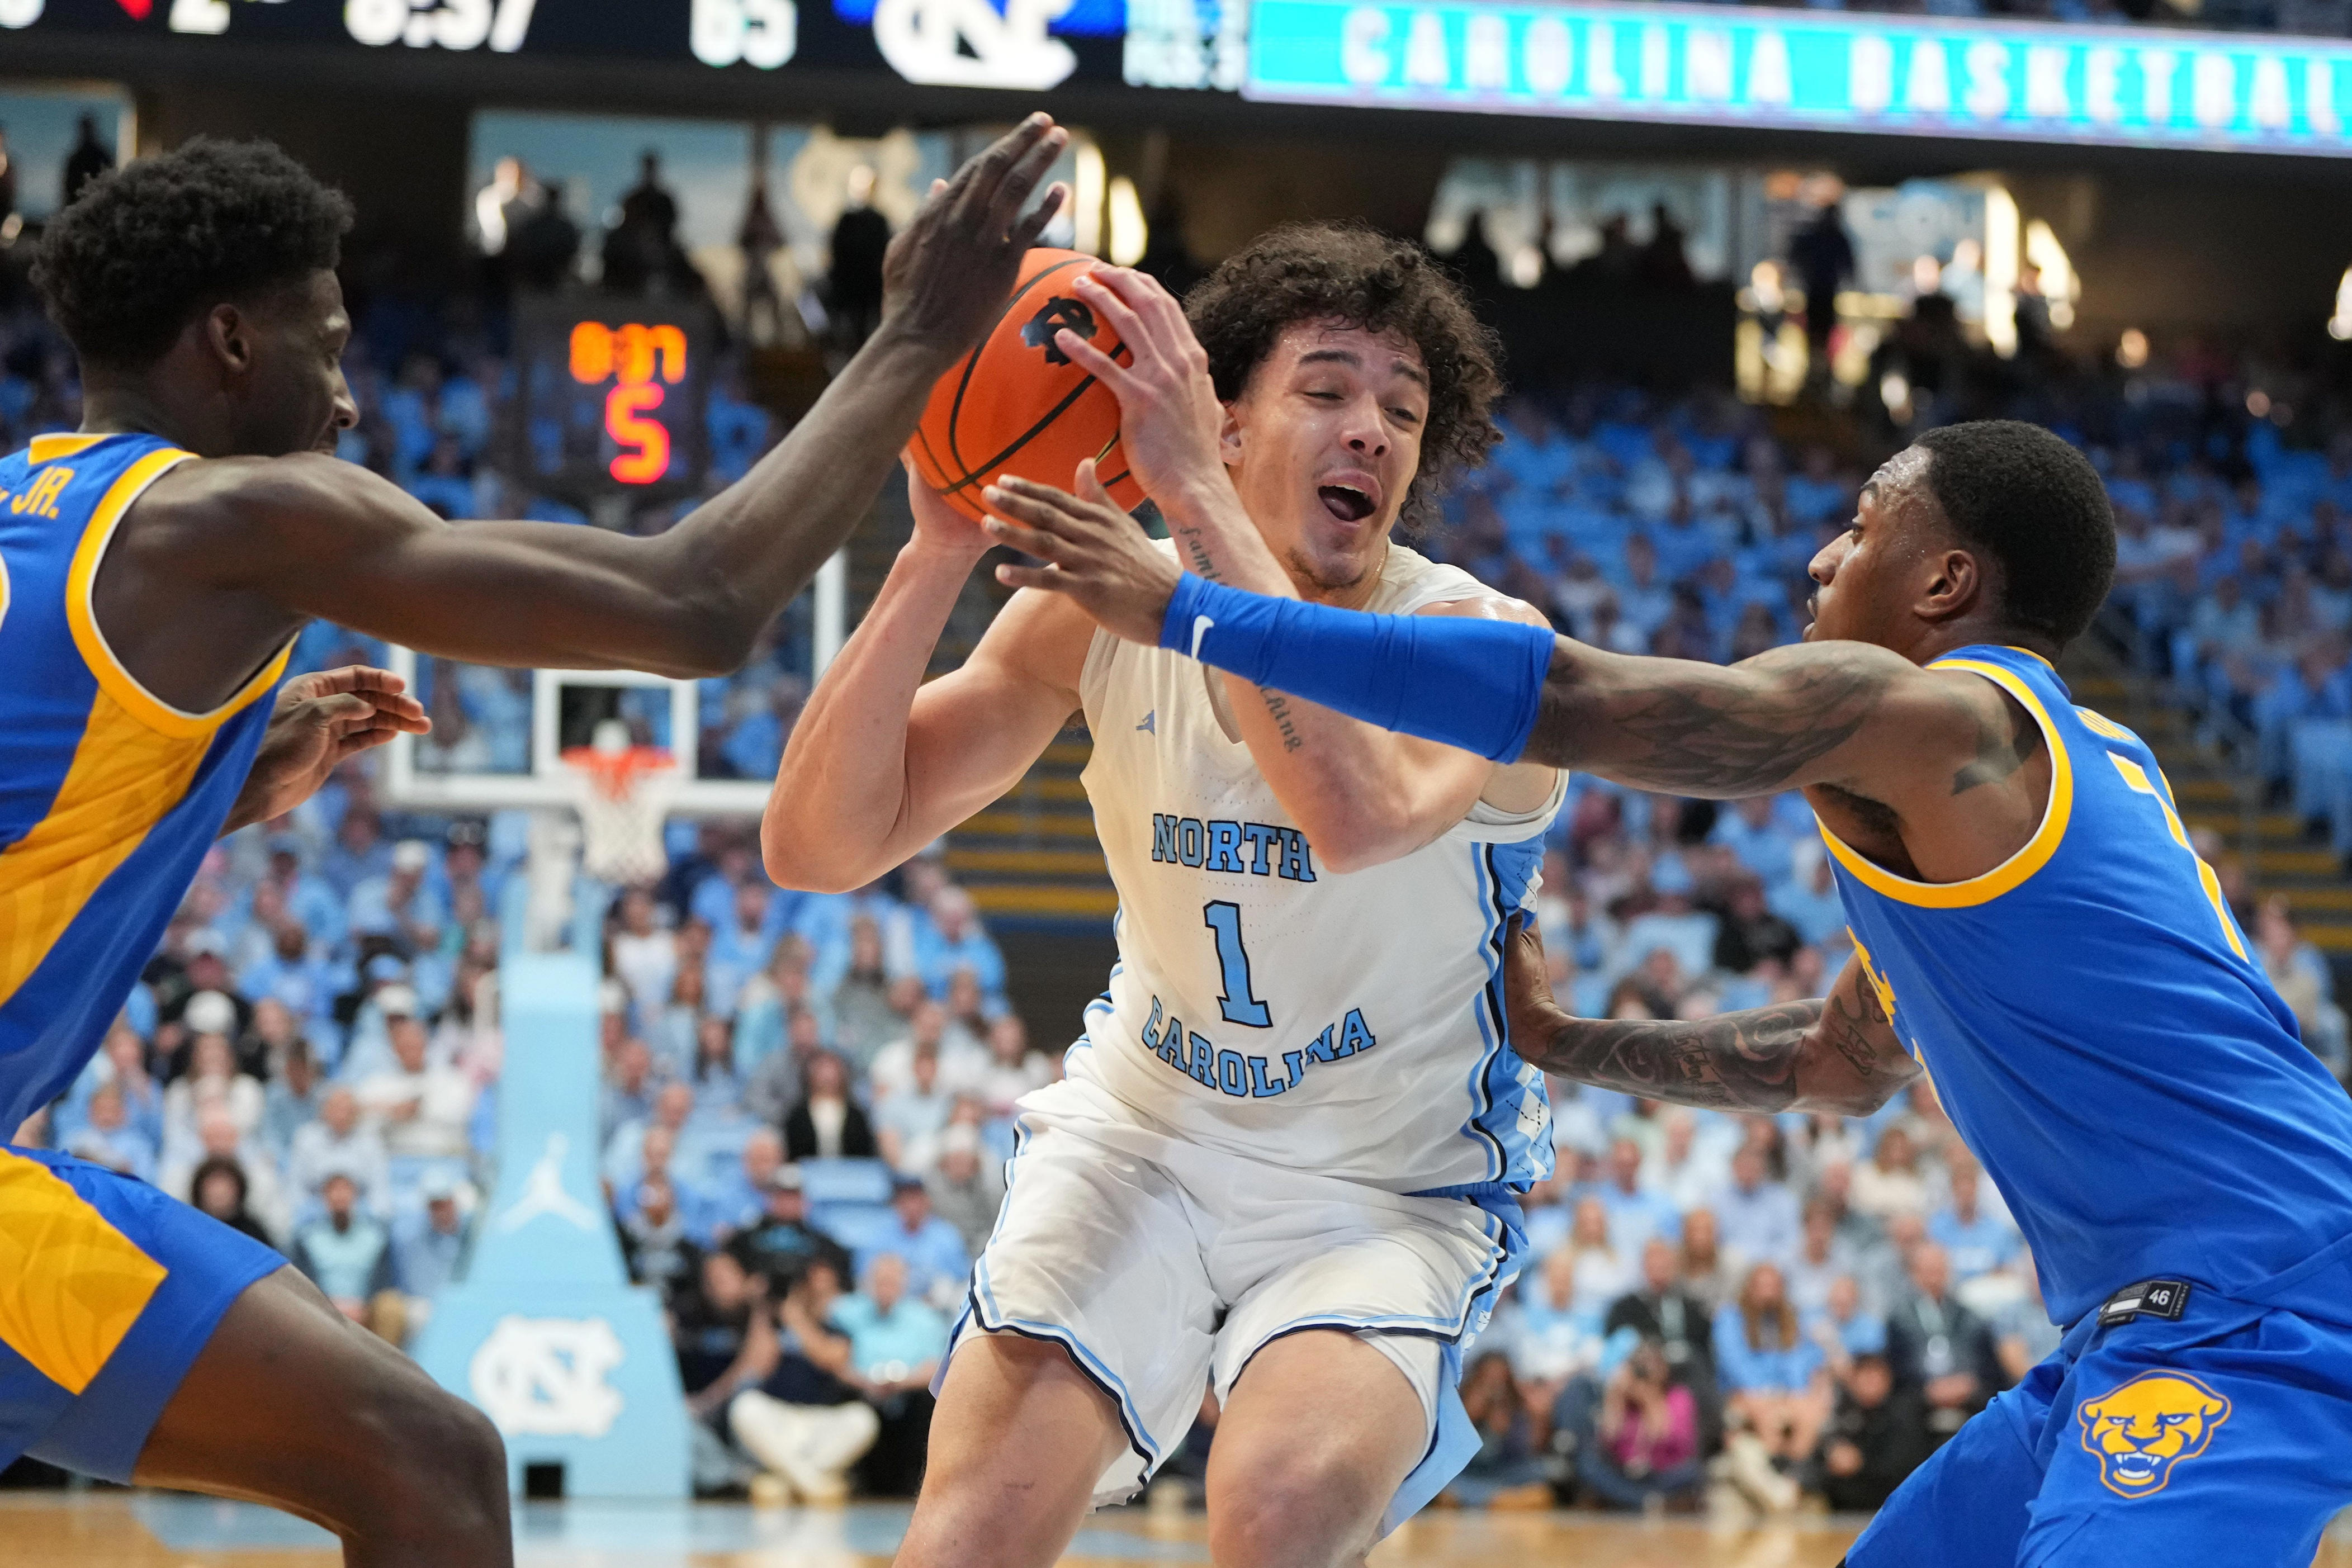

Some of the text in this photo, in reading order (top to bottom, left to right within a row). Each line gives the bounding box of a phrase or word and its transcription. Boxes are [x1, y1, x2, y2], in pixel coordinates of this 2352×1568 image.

[1341, 7, 1793, 104] CAROLINA
[605, 382, 670, 484] 5
[11, 466, 75, 519] JR.
[1152, 813, 1317, 883] NORTH
[1203, 899, 1273, 1029] 1
[1141, 994, 1376, 1098] CAROLINA
[2148, 1288, 2171, 1306] 46
